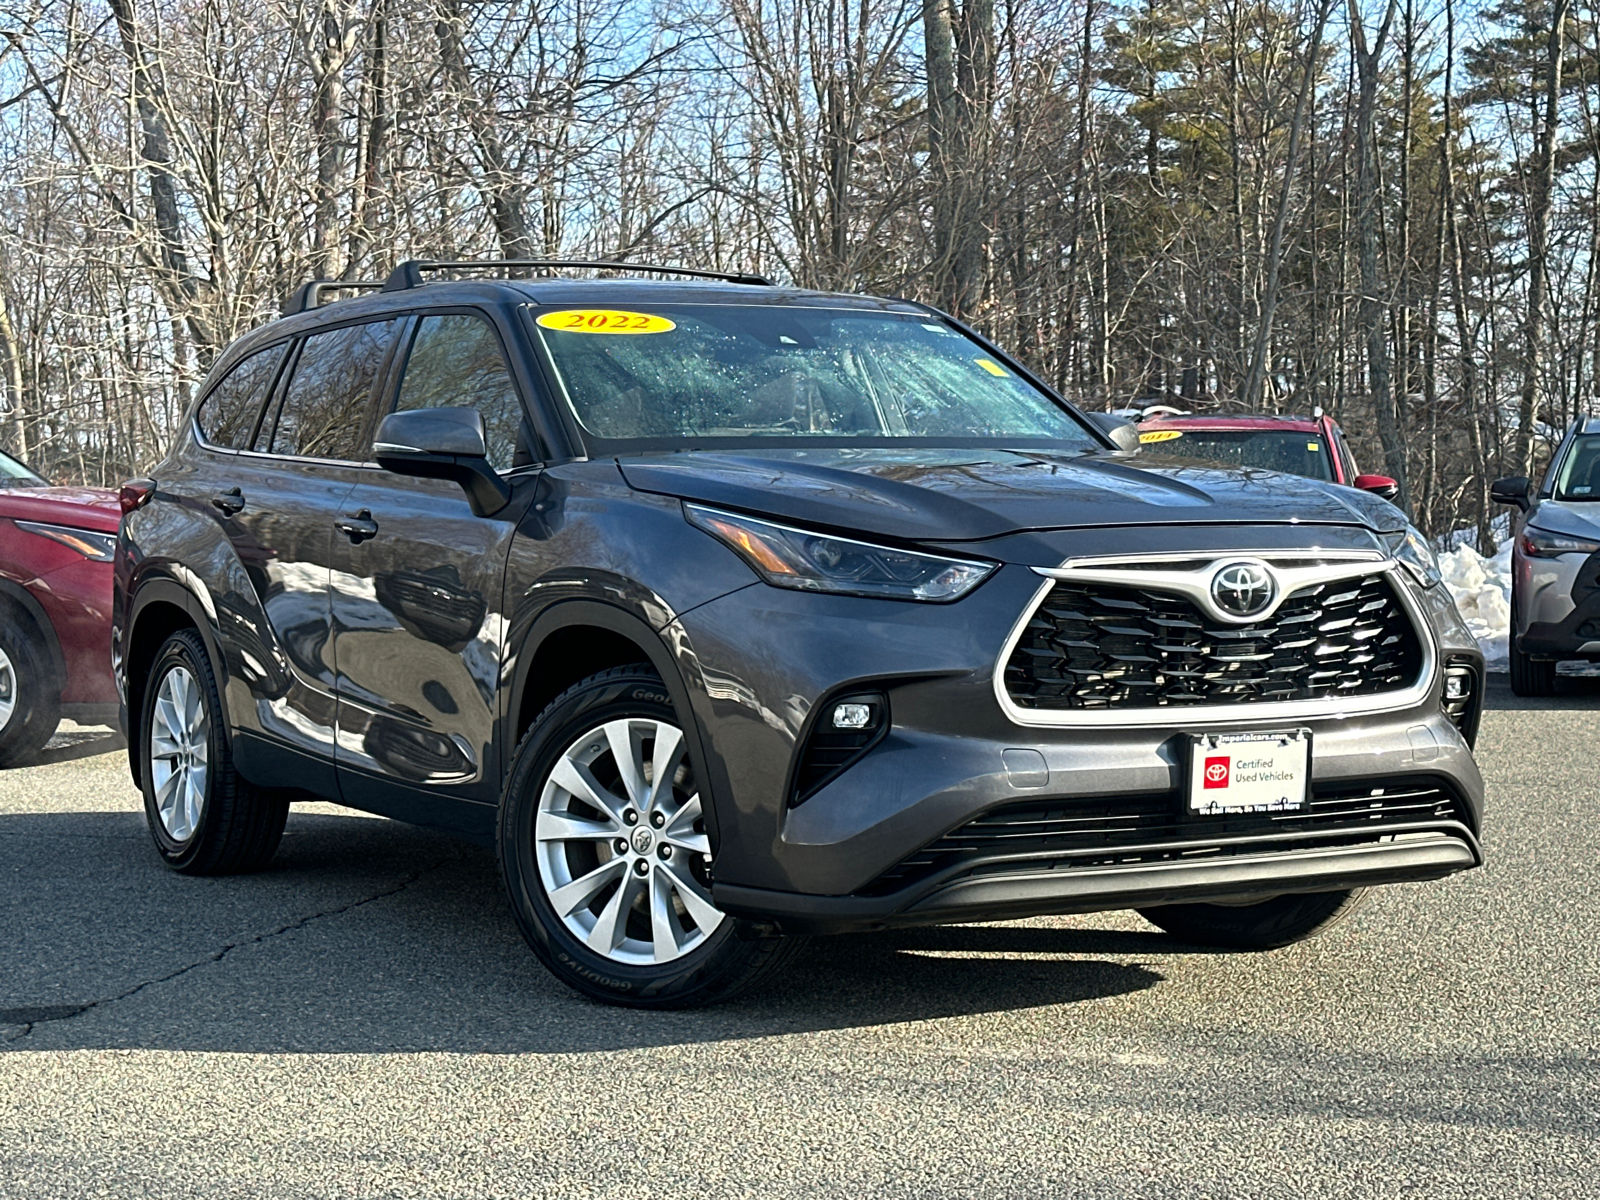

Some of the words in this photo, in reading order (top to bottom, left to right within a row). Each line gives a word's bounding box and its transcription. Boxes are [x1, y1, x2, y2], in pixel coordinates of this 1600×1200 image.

[564, 314, 651, 329] 2022
[1236, 758, 1274, 770] Certified
[1235, 773, 1257, 783] Used
[1258, 770, 1294, 782] Vehicles
[1254, 804, 1267, 812] You
[558, 952, 633, 992] GeoDrive
